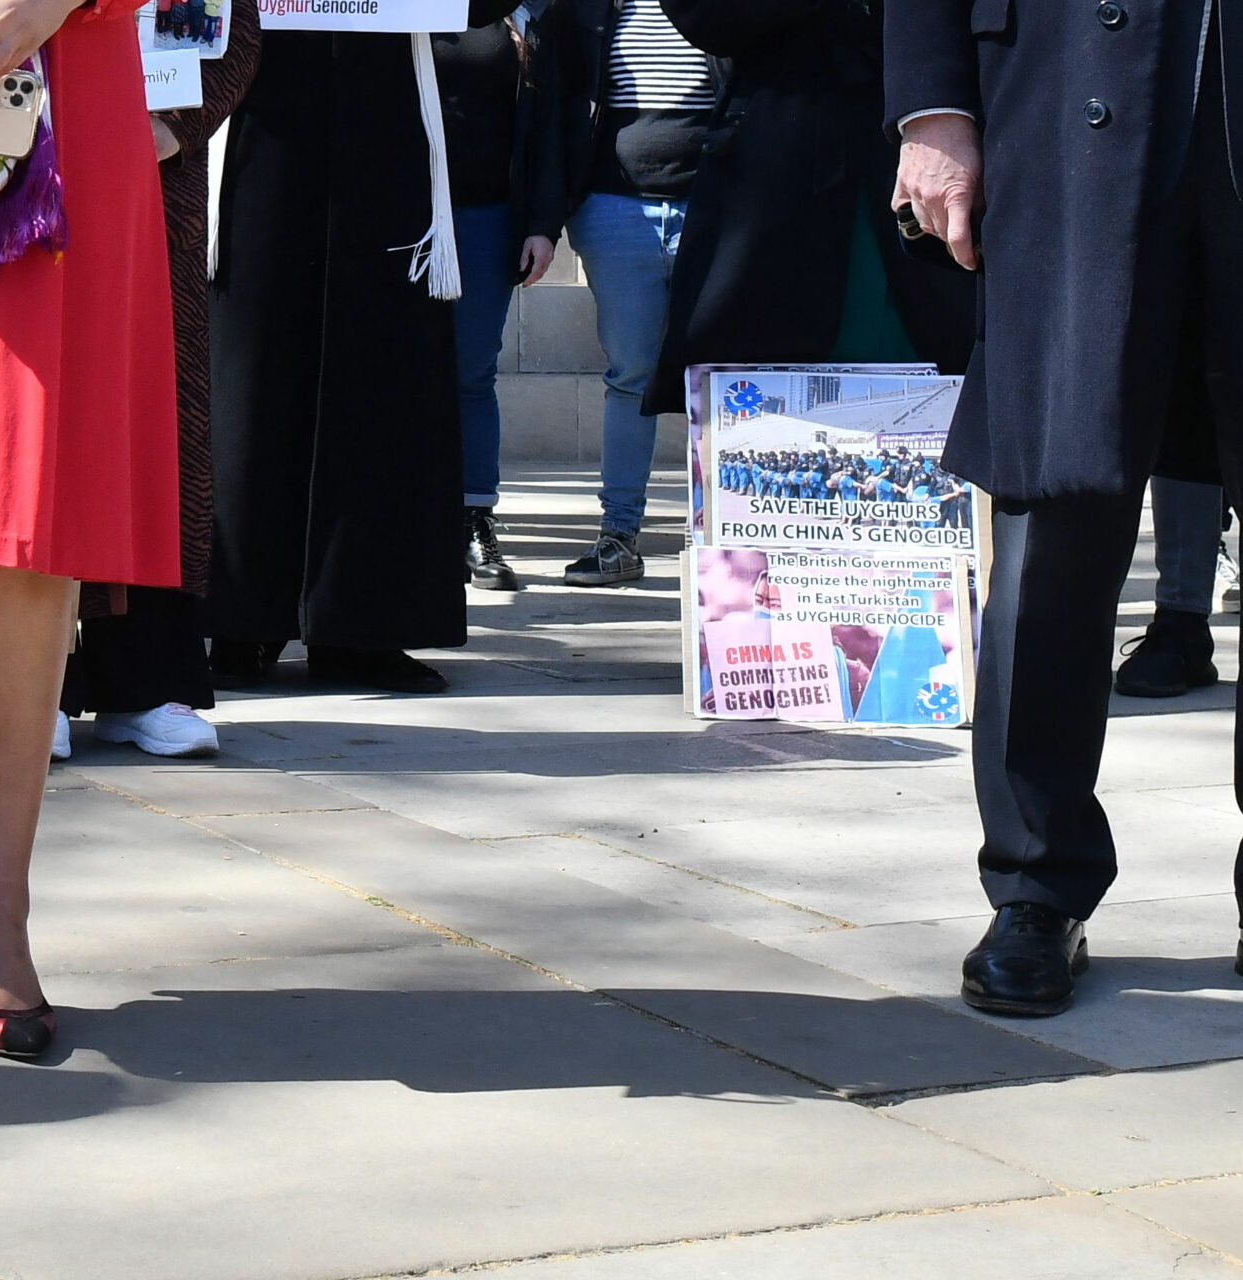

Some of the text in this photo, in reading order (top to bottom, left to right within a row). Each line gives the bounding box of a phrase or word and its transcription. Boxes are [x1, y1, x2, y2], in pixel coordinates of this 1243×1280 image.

[143, 68, 177, 85] mily?
[750, 499, 938, 519] SAVE THE UYGHURS
[722, 522, 777, 538] FROM
[868, 528, 969, 545] GENOCIDE
[768, 554, 950, 570] The British Government:
[768, 574, 840, 588] recognize
[845, 575, 871, 587] the
[873, 575, 951, 590] nightmare
[797, 592, 919, 607] in East Turkistan
[777, 610, 946, 626] as UYGHUR GENOCIDE
[725, 641, 813, 665] CHINA IS
[719, 664, 828, 687] COMMITTING
[724, 683, 832, 711] GENOCIDE!
